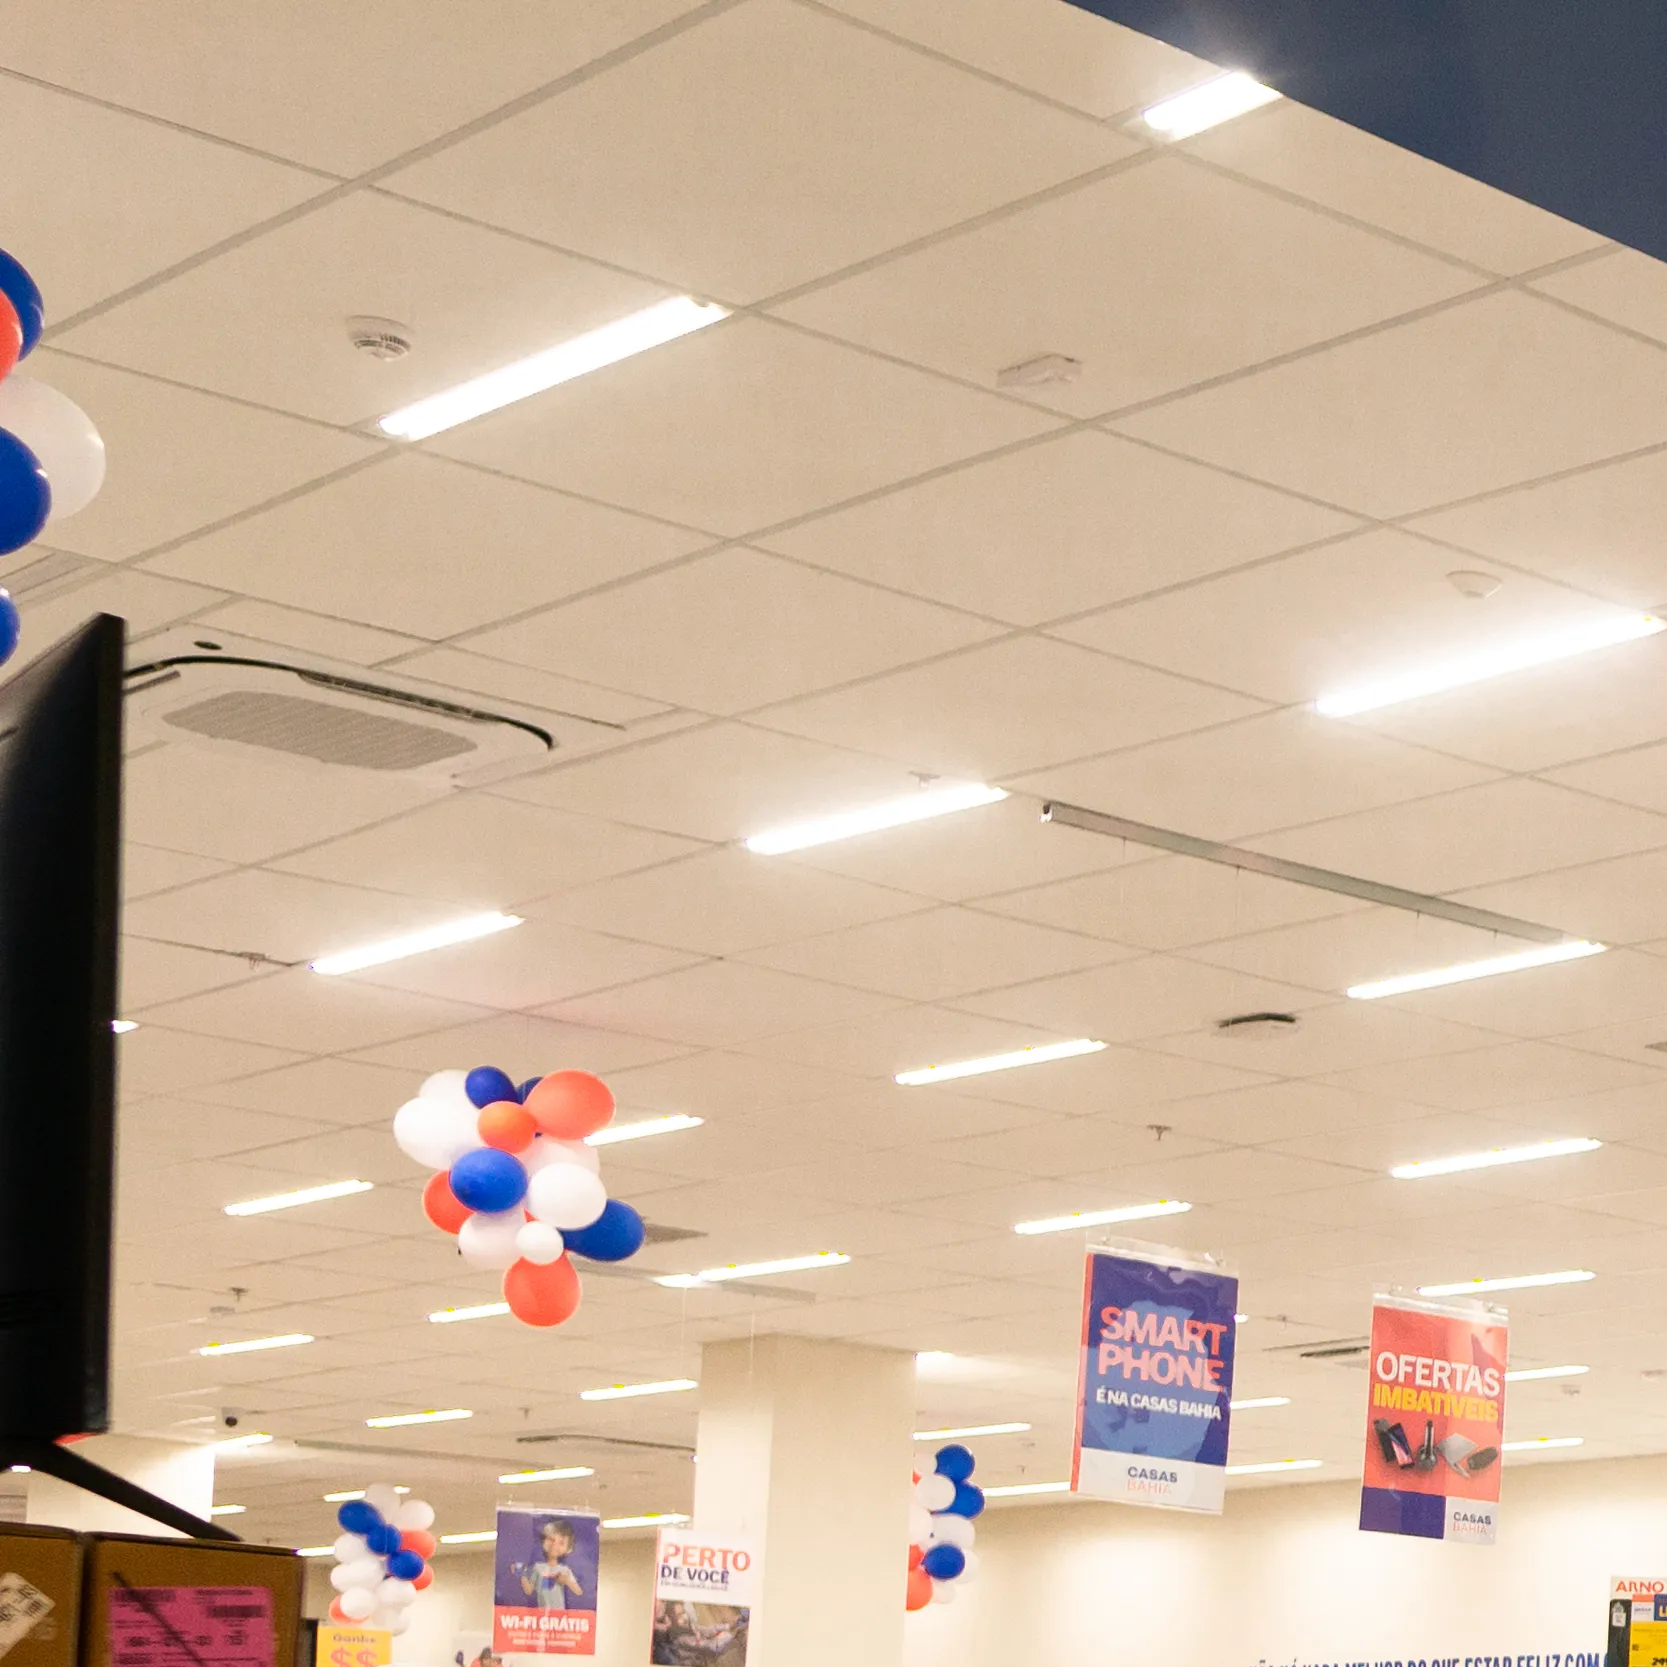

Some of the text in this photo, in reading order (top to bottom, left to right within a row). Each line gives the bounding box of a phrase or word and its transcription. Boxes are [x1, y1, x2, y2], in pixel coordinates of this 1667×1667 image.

[1100, 1306, 1228, 1356] SMART
[1097, 1342, 1225, 1393] PHONE
[1375, 1350, 1501, 1398] OFERTAS
[1096, 1386, 1222, 1421] É NA CASAS BAHIA
[1373, 1382, 1499, 1423] IMBATÍVEIS
[1127, 1466, 1178, 1483] CASAS
[1126, 1479, 1173, 1496] BAHIA
[1452, 1521, 1488, 1535] BAHIA
[1453, 1511, 1492, 1526] CASAS
[662, 1542, 751, 1572] PERTO
[660, 1564, 730, 1585] DE VOCÊ
[1615, 1579, 1665, 1594] ARNO
[501, 1613, 590, 1632] WI-FI GRÁTIS
